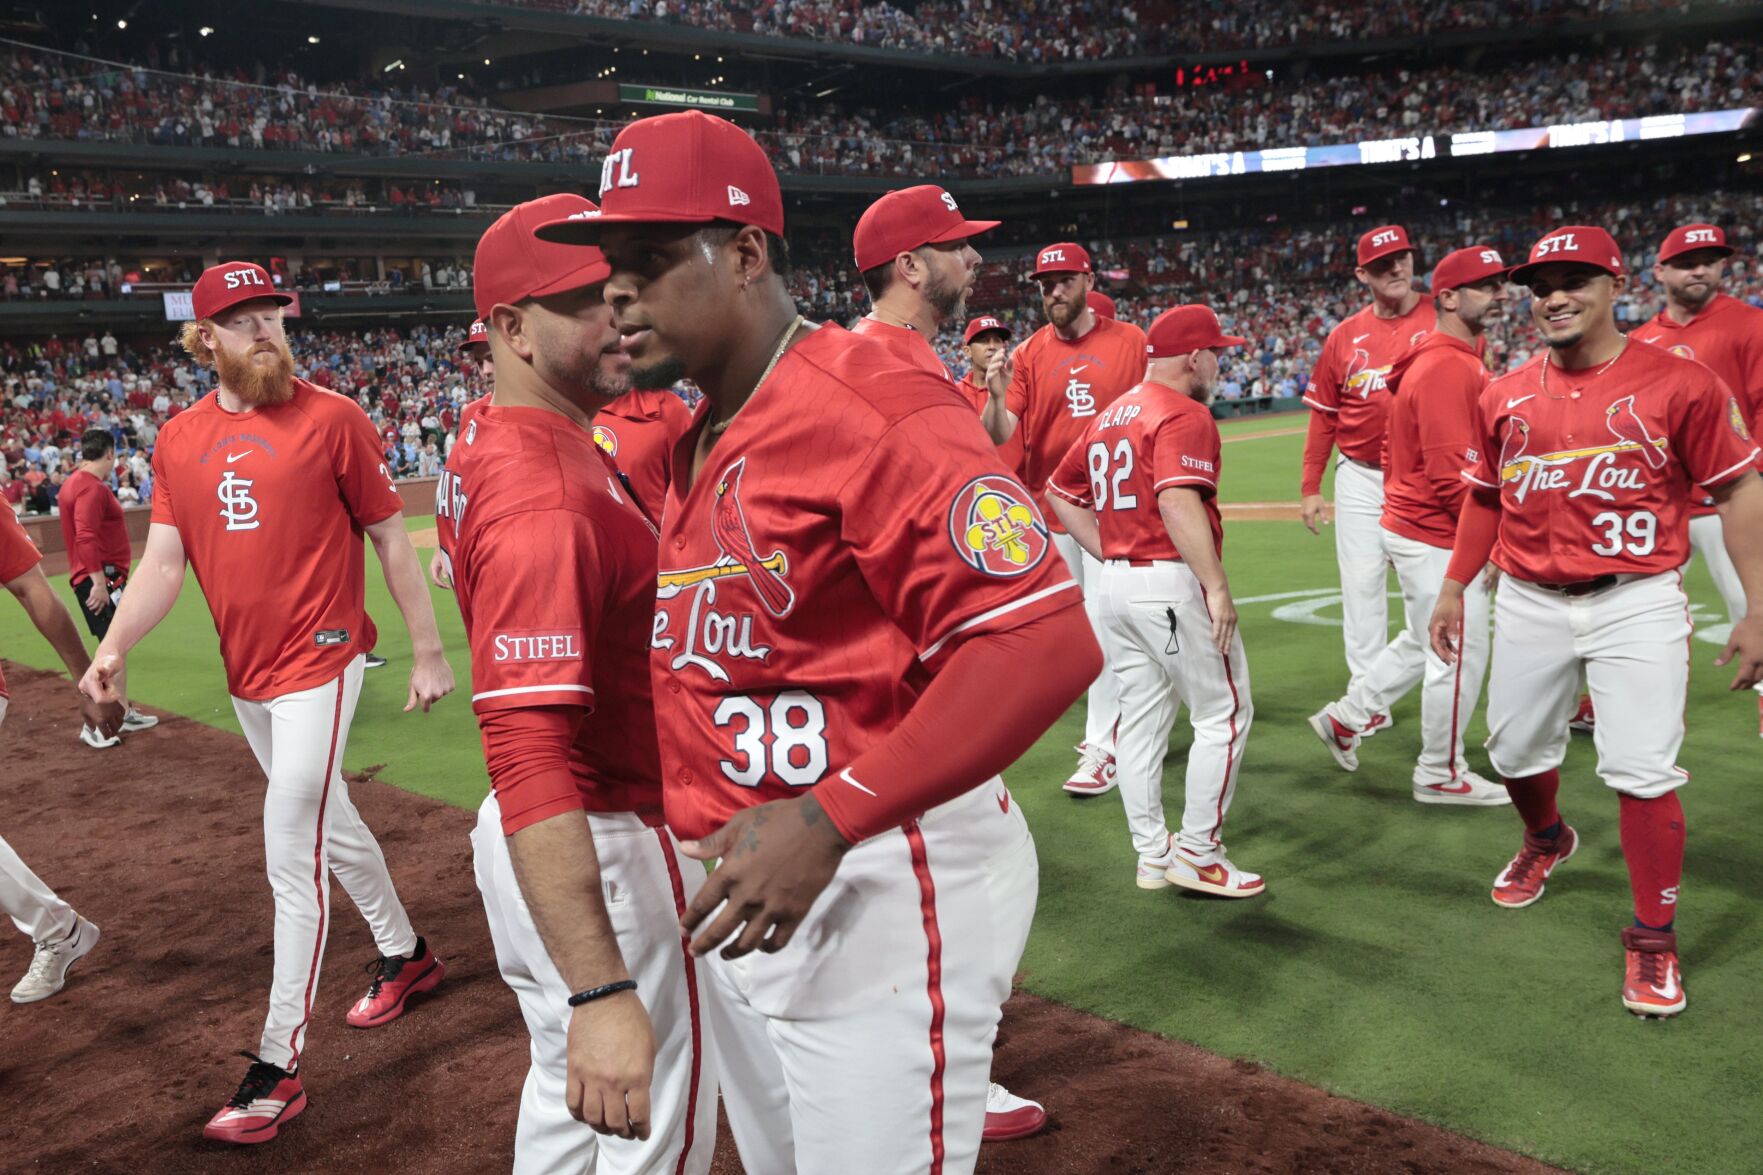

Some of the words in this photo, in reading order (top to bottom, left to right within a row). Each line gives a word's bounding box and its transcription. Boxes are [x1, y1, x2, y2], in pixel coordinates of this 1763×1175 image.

[1371, 230, 1399, 247] STL
[1536, 233, 1579, 258] STL
[1684, 229, 1717, 244] STL
[1041, 250, 1066, 264] STL
[223, 268, 265, 289] STL
[980, 318, 1000, 328] STL
[1098, 404, 1142, 432] CLAPP
[1087, 438, 1137, 512] 82
[1181, 455, 1215, 473] STIFEL
[1506, 455, 1575, 505] The
[1568, 452, 1647, 501] Lou
[980, 512, 1021, 541] STL
[1592, 511, 1657, 556] 39
[671, 577, 770, 684] Lou
[494, 634, 580, 661] STIFEL
[713, 690, 829, 787] 38
